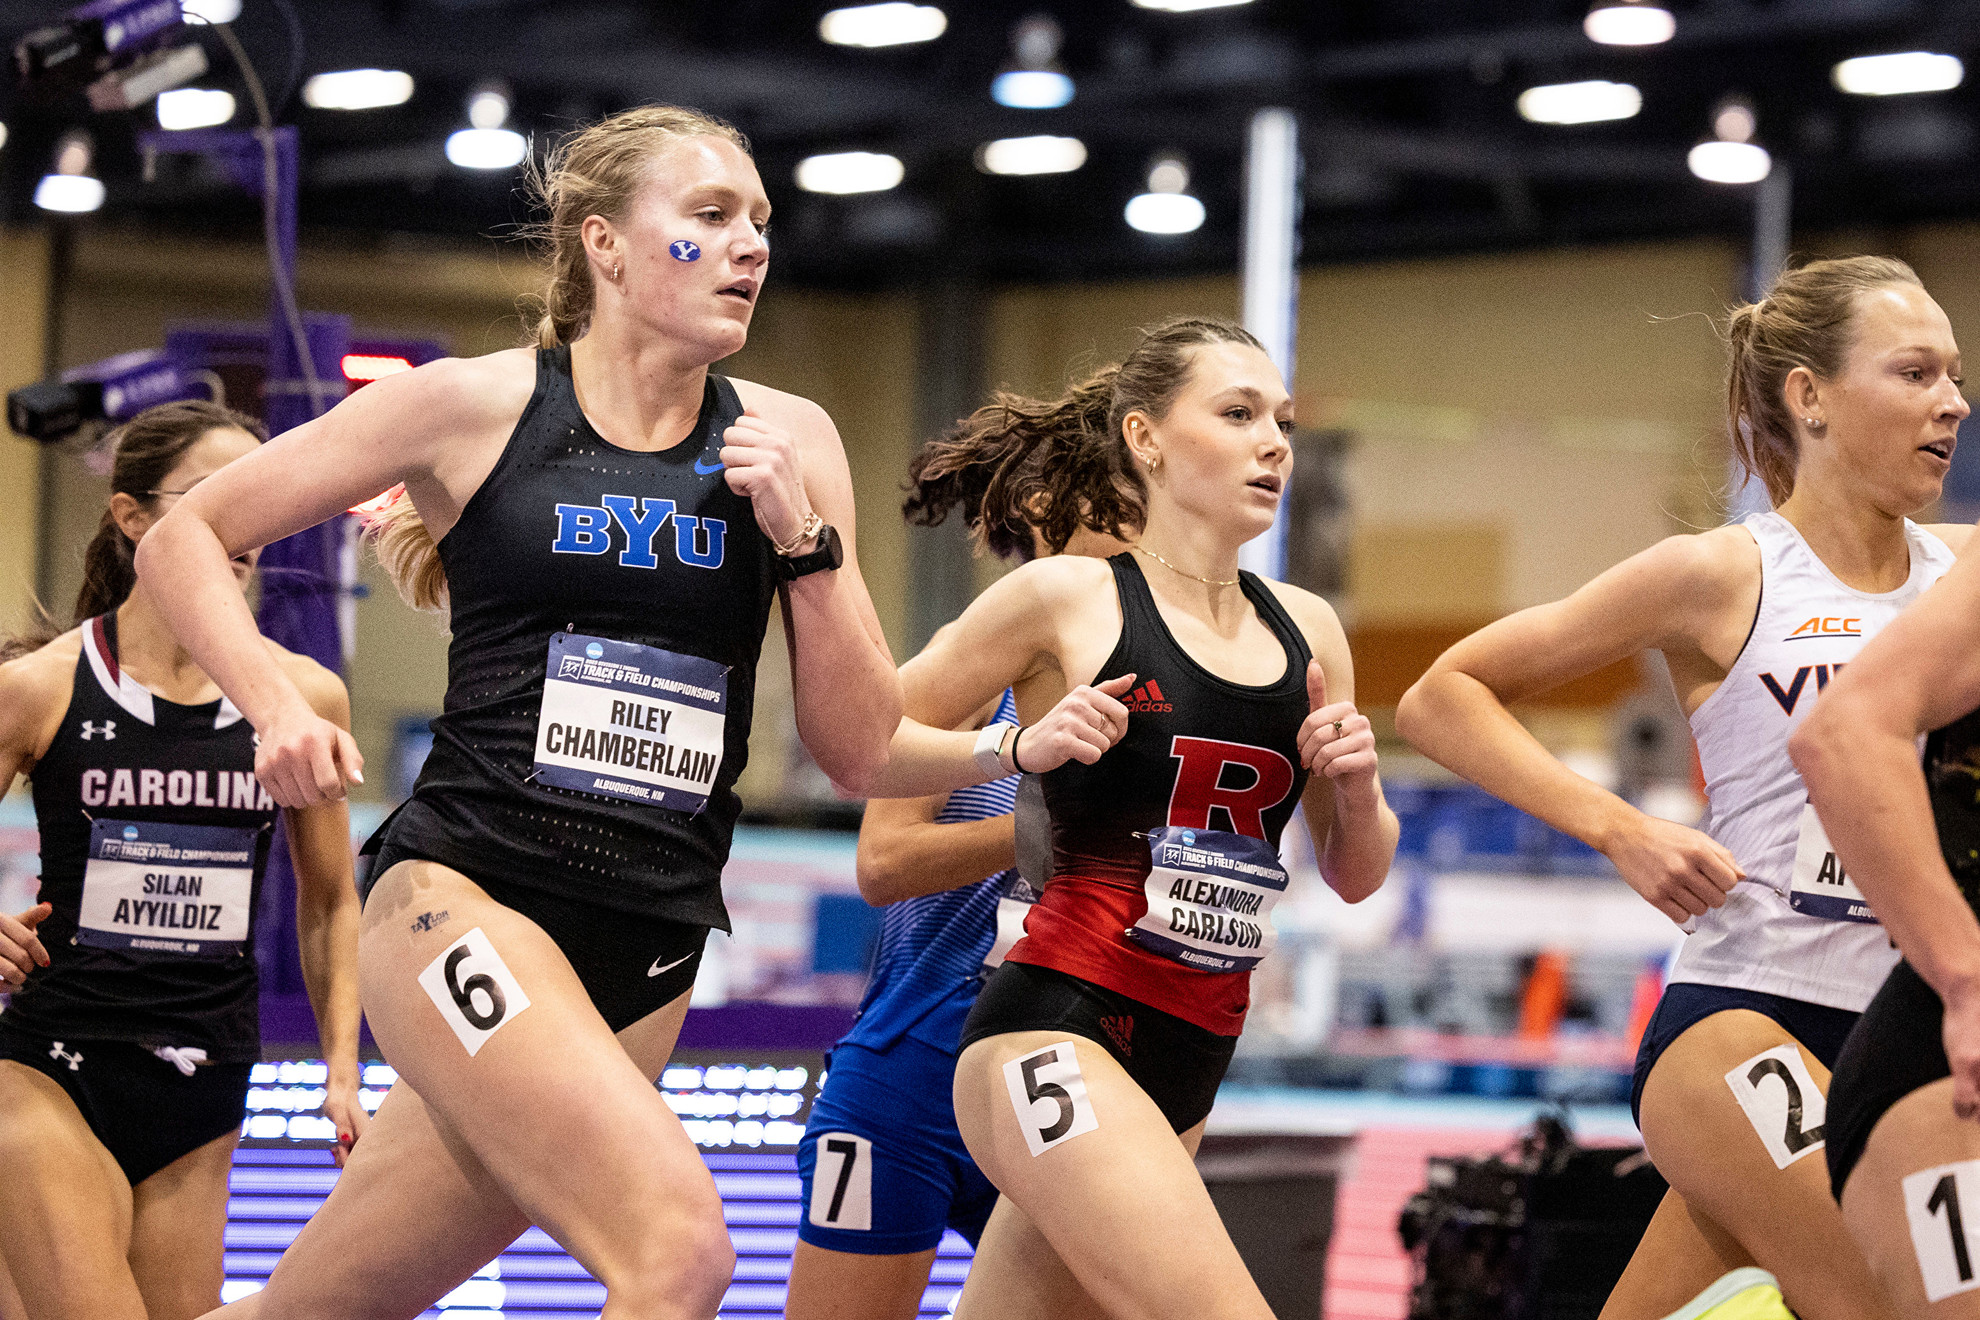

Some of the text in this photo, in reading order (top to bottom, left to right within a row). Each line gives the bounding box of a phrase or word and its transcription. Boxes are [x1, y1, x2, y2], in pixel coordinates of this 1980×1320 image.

[674, 241, 698, 260] Y
[552, 494, 727, 569] BYU
[1790, 617, 1862, 636] ACC
[583, 664, 616, 680] TRACK
[615, 670, 625, 682] &
[624, 671, 651, 686] FIELD
[651, 678, 720, 703] CHAMPIONSHIPS
[1758, 663, 1849, 717] VI
[610, 699, 672, 734] RILEY
[1127, 700, 1173, 713] didas
[546, 722, 716, 784] CHAMBERLAIN
[593, 778, 665, 801] ALBUQUERQUE, NM
[1166, 735, 1295, 842] R
[142, 873, 202, 897] SILAN
[1182, 850, 1207, 865] TRACK
[1207, 856, 1213, 866] &
[1214, 857, 1234, 869] FIELD
[1234, 861, 1286, 882] CHAMPIONSHIPS
[113, 898, 222, 930] AYYILDIZ
[1169, 878, 1264, 916] ALEXANDRA
[1169, 907, 1263, 949] CARLSON
[444, 944, 507, 1031] 6
[1020, 1049, 1075, 1144] 5
[1747, 1058, 1826, 1155] 2
[827, 1139, 857, 1223] 7
[1927, 1173, 1973, 1282] 1
